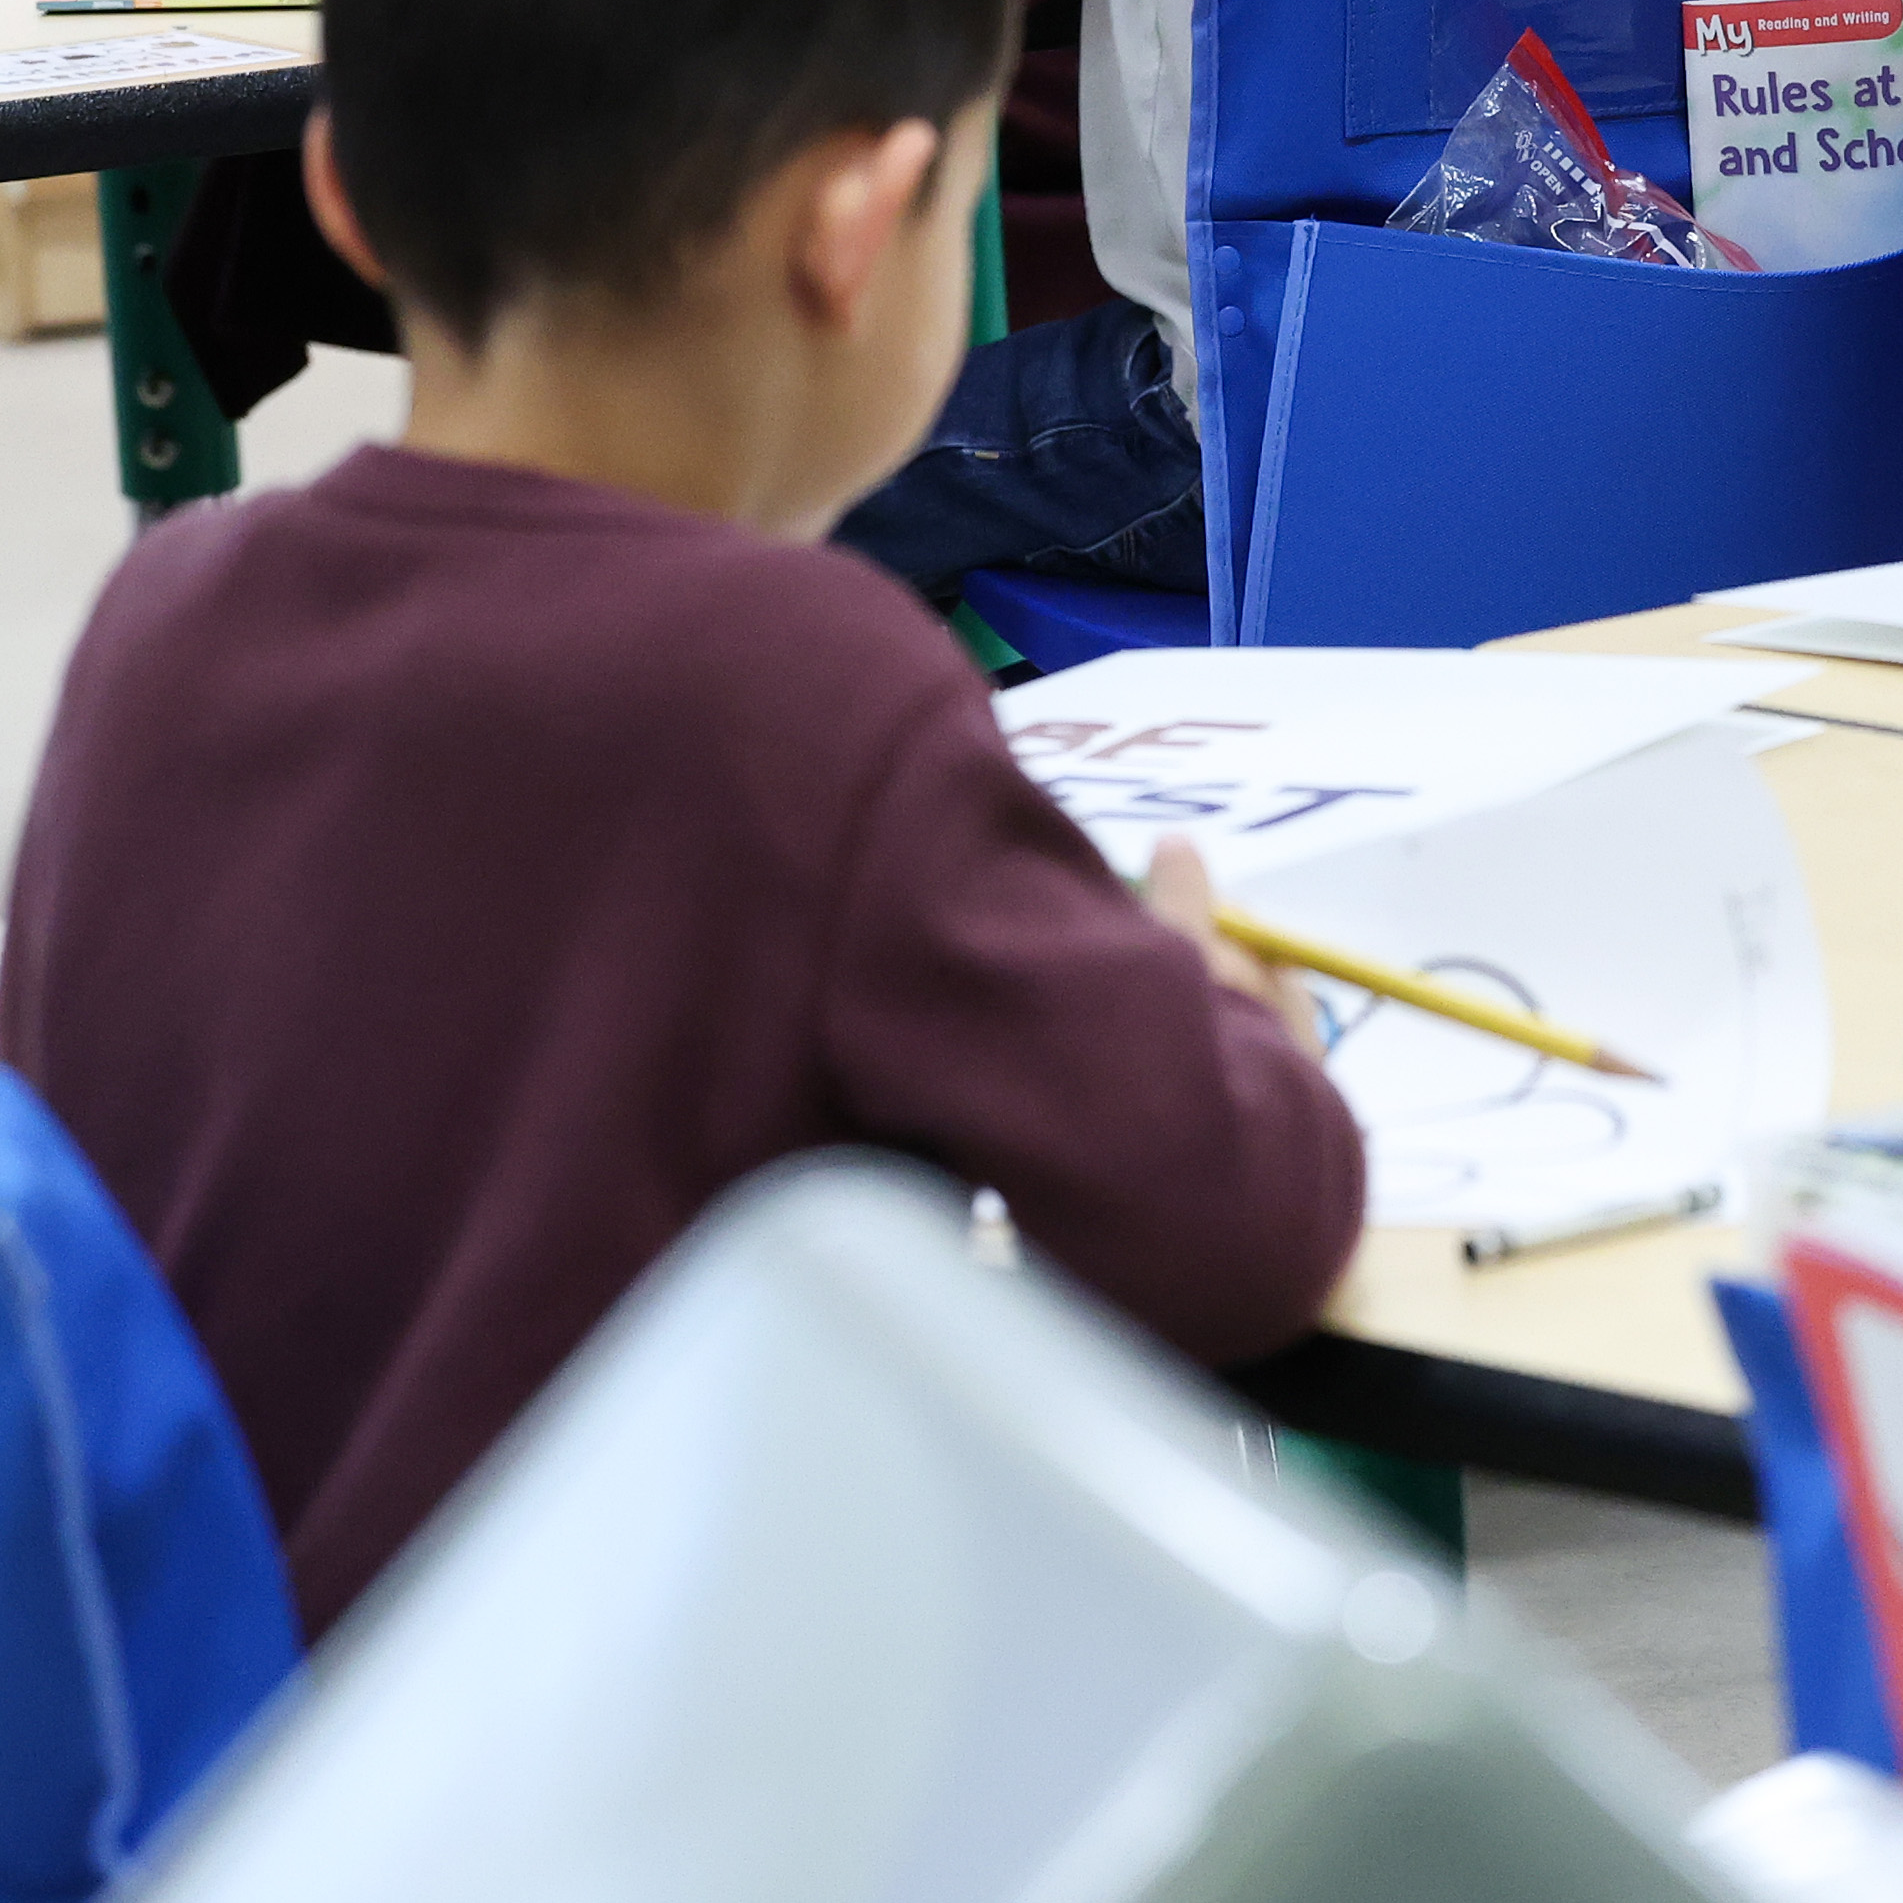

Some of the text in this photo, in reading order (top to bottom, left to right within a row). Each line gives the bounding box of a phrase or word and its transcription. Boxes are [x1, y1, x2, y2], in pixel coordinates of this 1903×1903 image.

[1695, 9, 1890, 56] My Reading and Writing
[1712, 71, 1834, 118] Rules
[1853, 65, 1901, 108] at
[1719, 131, 1799, 177] and
[1530, 159, 1566, 196] OPEN
